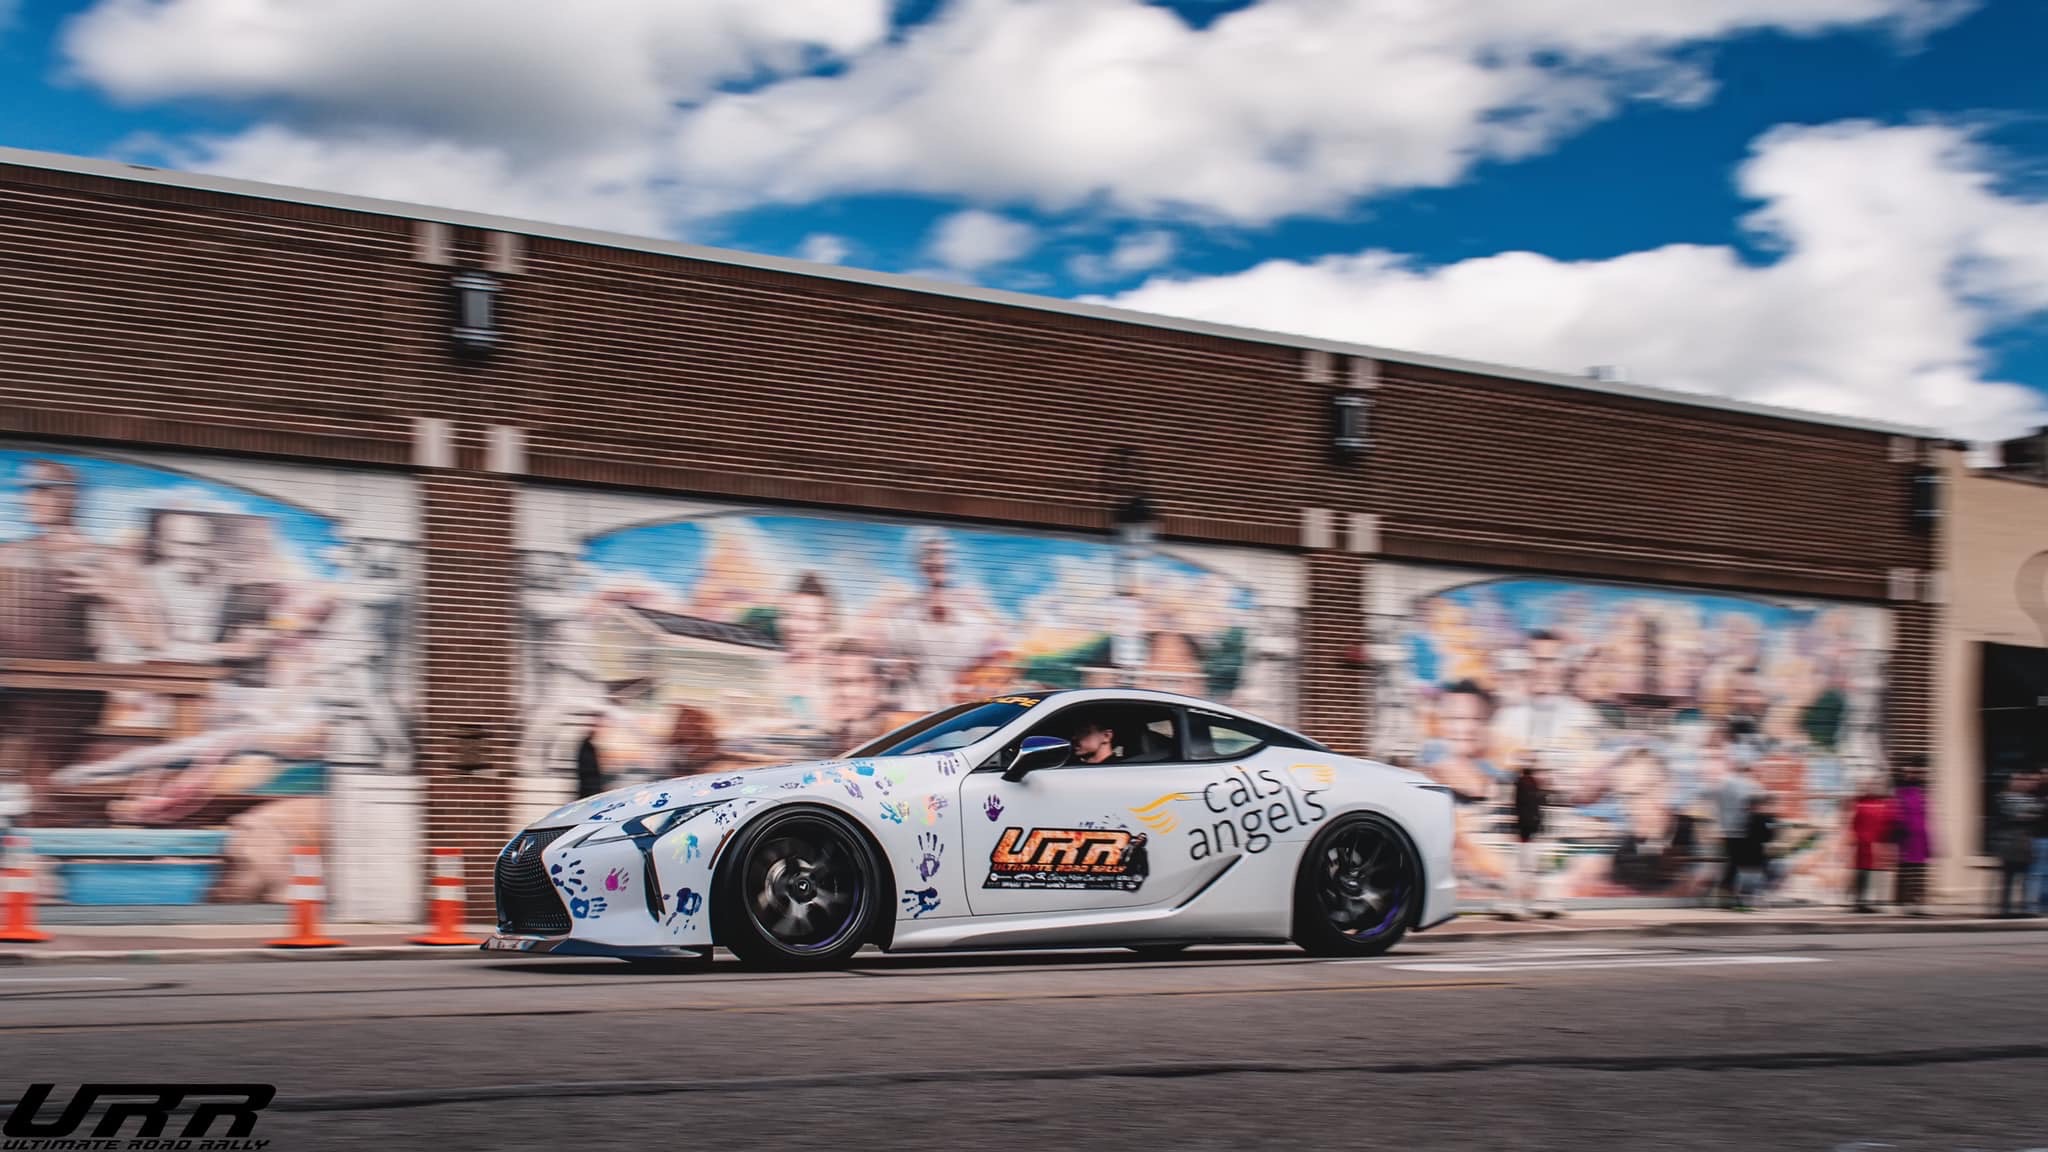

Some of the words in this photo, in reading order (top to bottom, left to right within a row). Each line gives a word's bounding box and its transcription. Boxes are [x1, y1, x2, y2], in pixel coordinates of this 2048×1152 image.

[1203, 765, 1283, 814] cals
[1187, 785, 1328, 861] angels
[991, 828, 1130, 864] URR
[992, 863, 1053, 872] ULTIMATE
[1055, 864, 1088, 872] ROAD
[1090, 865, 1127, 873] RALLY
